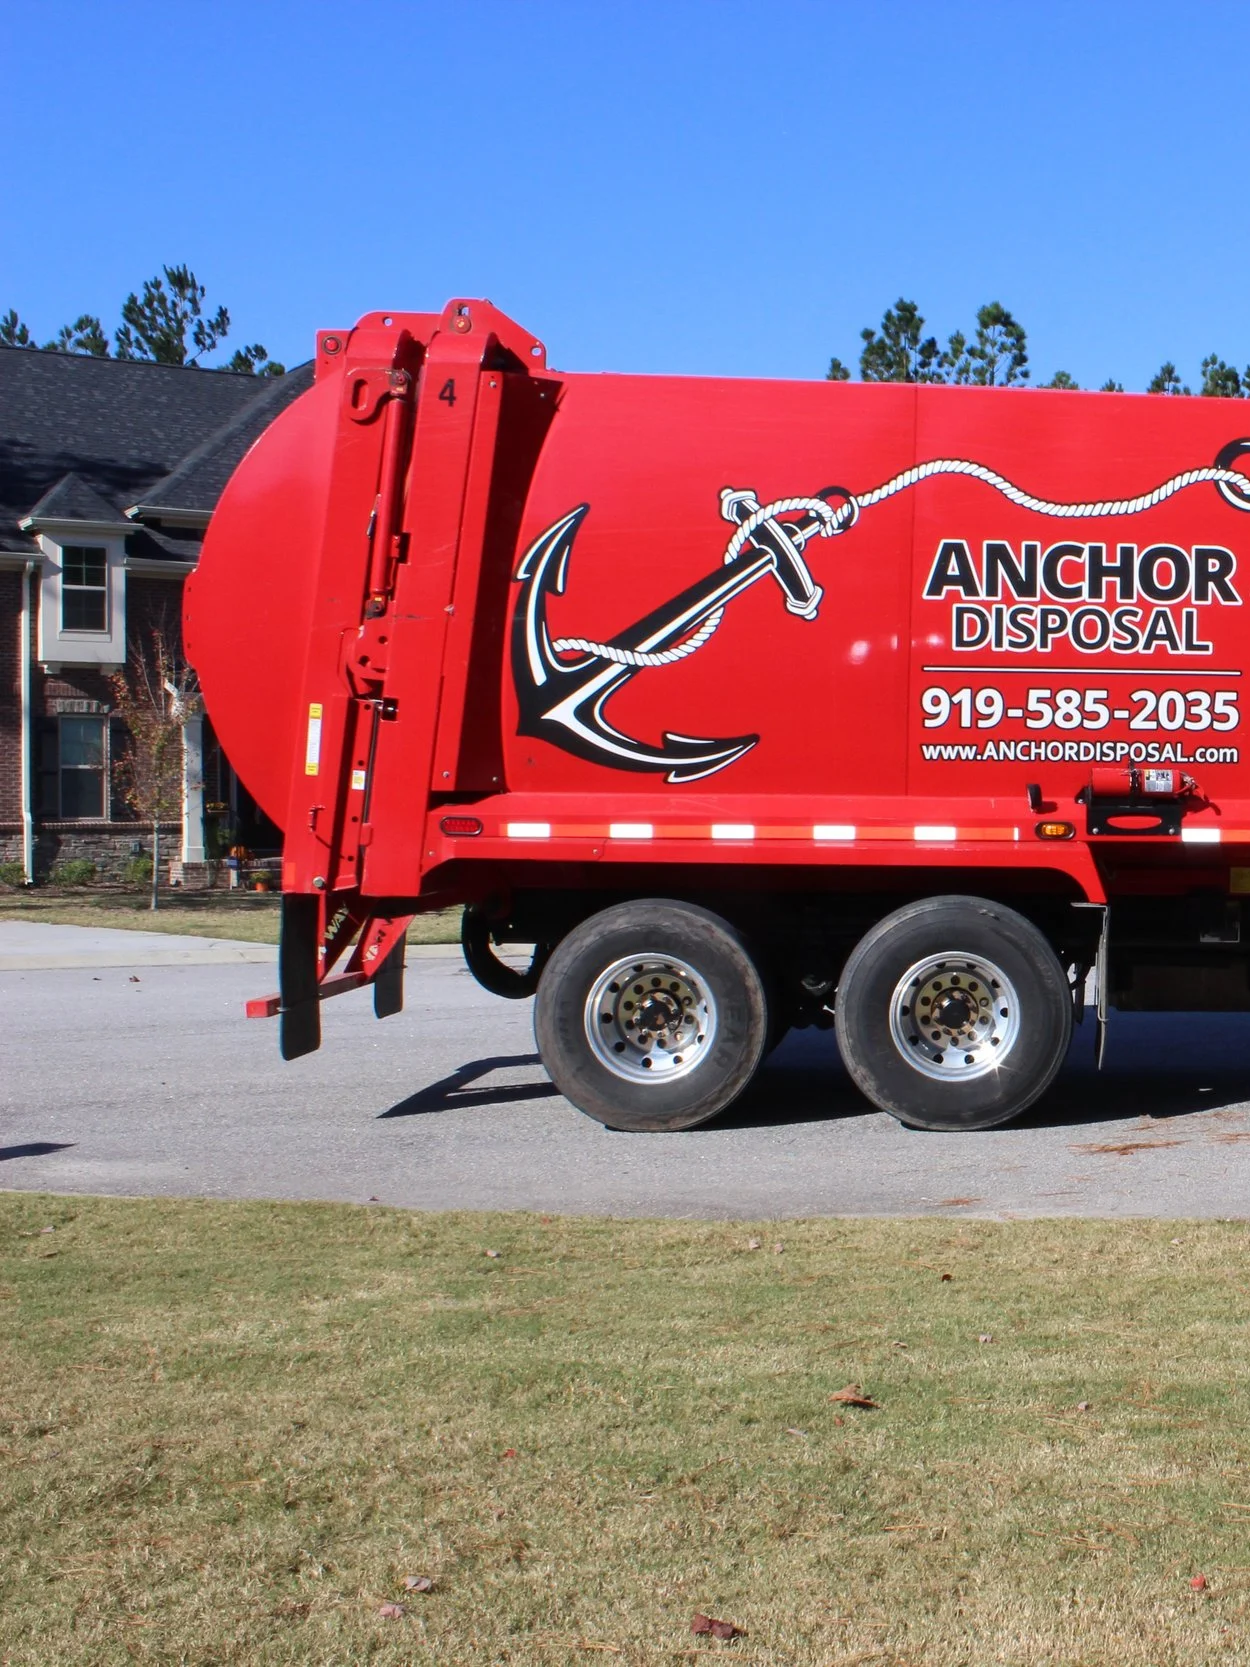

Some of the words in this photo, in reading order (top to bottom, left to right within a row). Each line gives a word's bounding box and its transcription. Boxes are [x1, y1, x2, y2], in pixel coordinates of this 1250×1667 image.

[438, 378, 457, 407] 4
[922, 539, 1242, 605] ANCHOR
[952, 603, 1213, 655] DISPOSAL
[922, 688, 1239, 731] 919-585-2035
[922, 739, 1239, 764] www.ANCHORDISPOSAL.com
